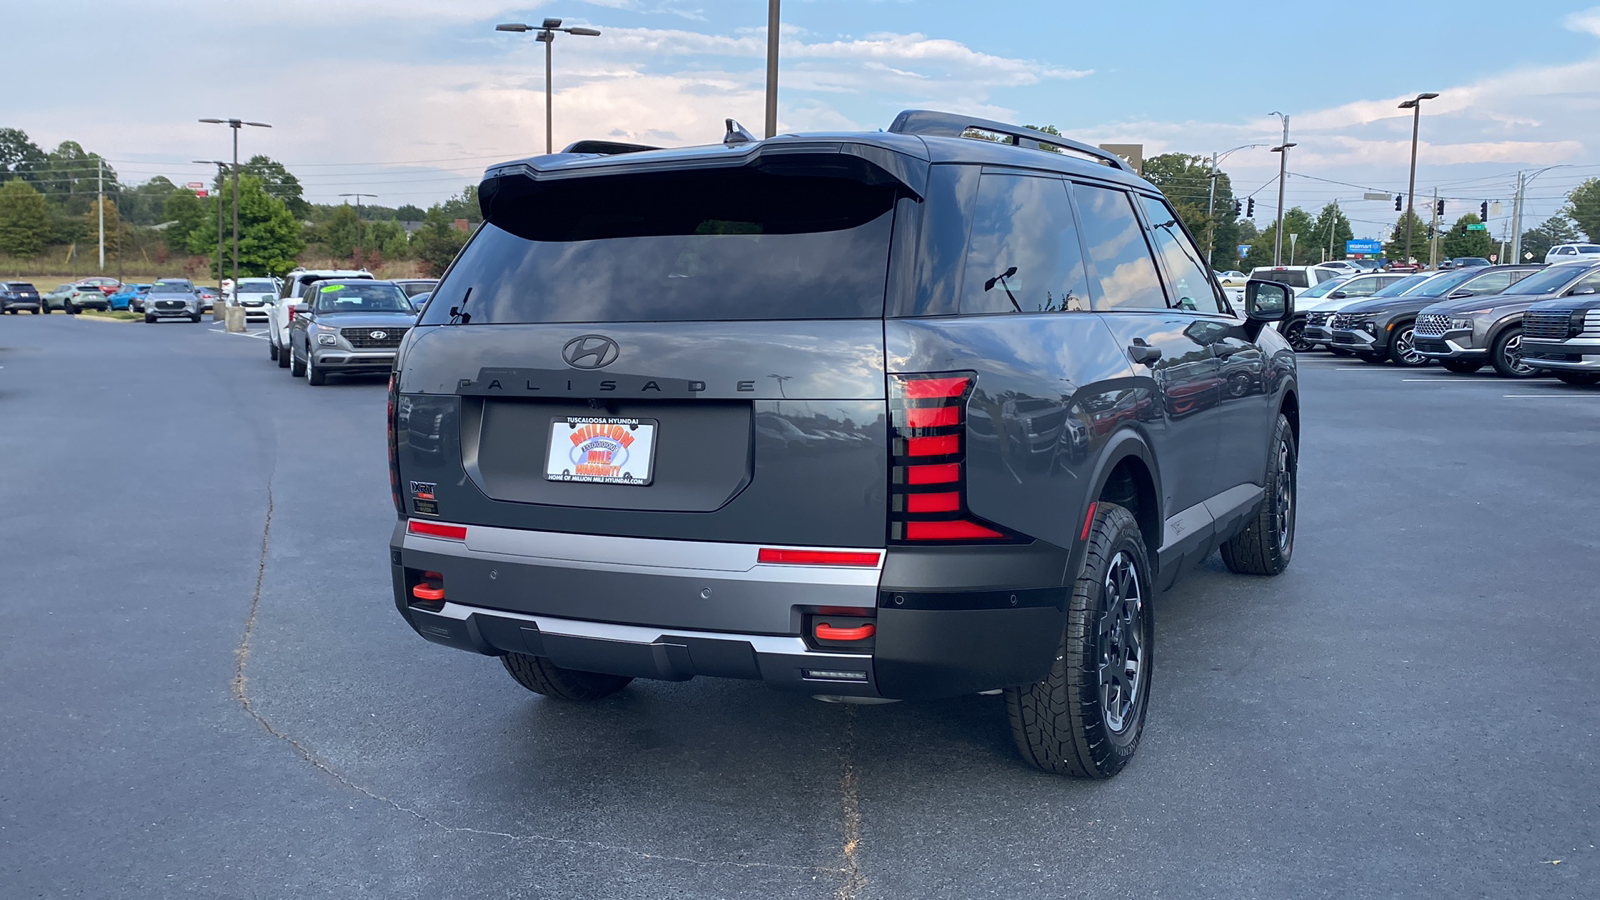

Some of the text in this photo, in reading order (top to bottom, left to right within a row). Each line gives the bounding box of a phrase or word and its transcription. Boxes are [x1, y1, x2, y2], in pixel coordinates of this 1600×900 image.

[459, 379, 755, 392] PALISADE
[570, 423, 635, 449] MILLION
[588, 450, 612, 465] MILE
[575, 464, 622, 477] WARRANTY
[410, 481, 437, 494] XRT
